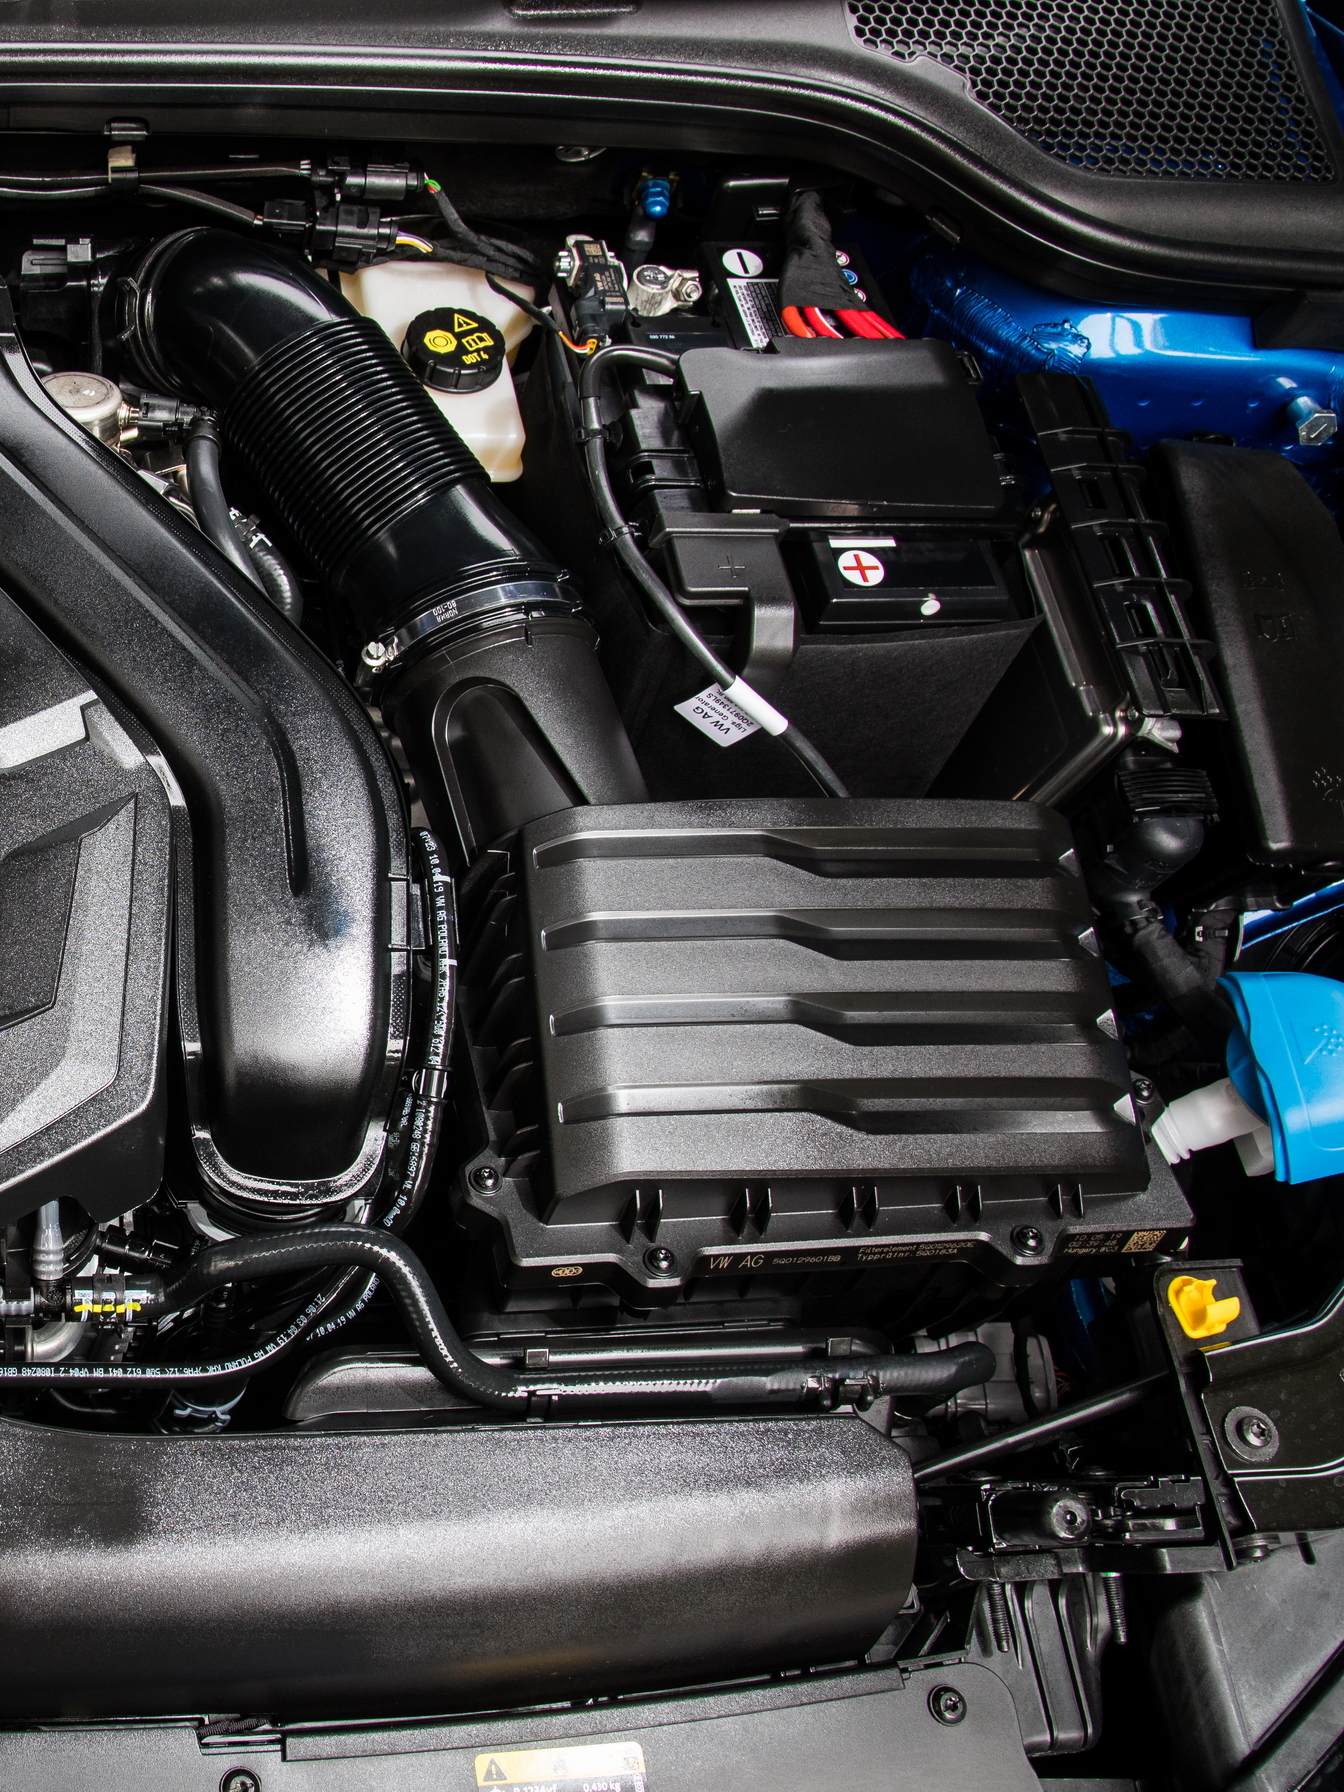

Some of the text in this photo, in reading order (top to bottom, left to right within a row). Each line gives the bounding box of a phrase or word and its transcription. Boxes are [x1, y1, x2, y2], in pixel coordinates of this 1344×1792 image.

[462, 350, 489, 365] DOT 4
[436, 607, 459, 622] NORMA
[692, 706, 713, 720] AG
[694, 696, 729, 721] Generator
[710, 719, 731, 735] VW
[435, 895, 446, 907] VW
[436, 910, 447, 921] AG
[438, 923, 449, 958] POLAND
[402, 1180, 414, 1190] VL
[859, 1244, 918, 1254] Filterelement
[1064, 1247, 1098, 1255] Hungary
[710, 1254, 841, 1270] VW AG 5Q0129601BB
[305, 1293, 326, 1316] 21:06
[316, 1315, 347, 1338] 10.04.19
[345, 1308, 357, 1320] VW
[355, 1301, 365, 1312] AG
[362, 1277, 380, 1303] POLAND
[277, 1314, 308, 1345] 03.04.19
[265, 1342, 277, 1353] VW
[253, 1349, 265, 1361] AG
[206, 1364, 222, 1375] KAK
[225, 1356, 253, 1371] POLAND
[59, 1367, 90, 1377] VP04.2
[93, 1367, 104, 1377] BM
[108, 1367, 124, 1377] 041
[126, 1367, 142, 1377] 612
[609, 1780, 622, 1792] kg
